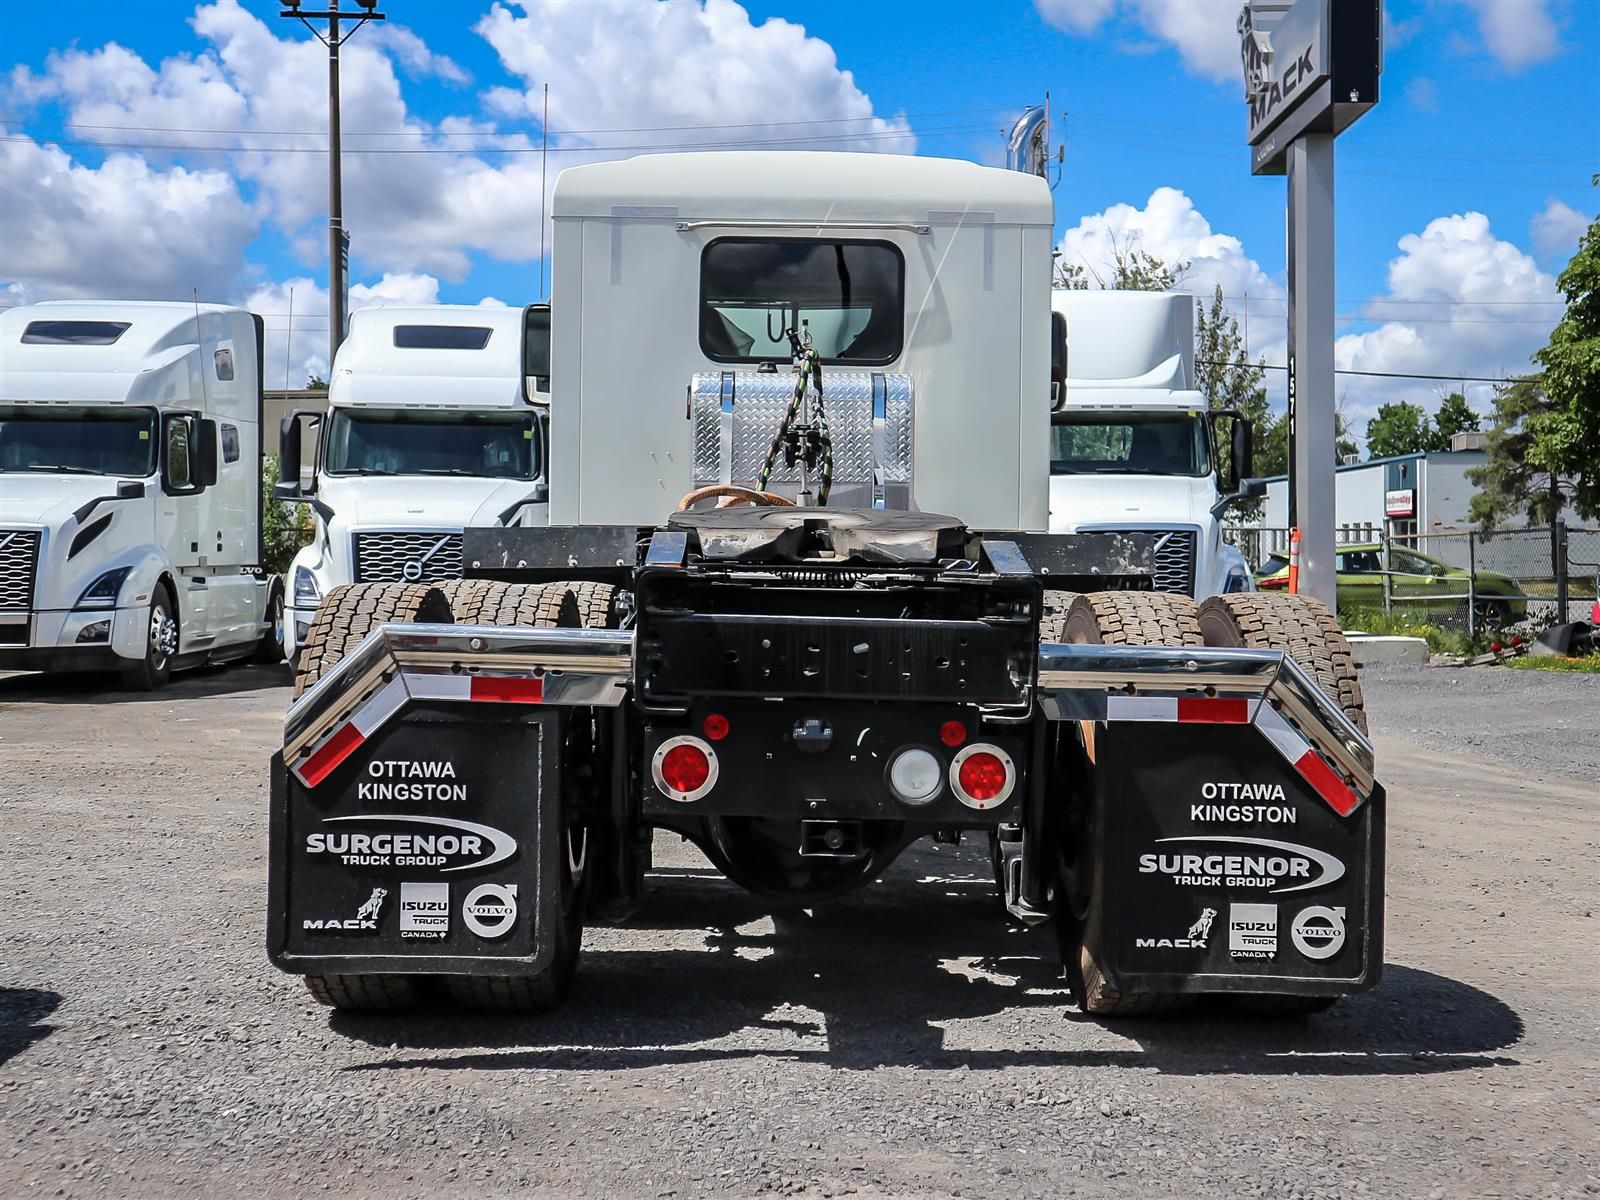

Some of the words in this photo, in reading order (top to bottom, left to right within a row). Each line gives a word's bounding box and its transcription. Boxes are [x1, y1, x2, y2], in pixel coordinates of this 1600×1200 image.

[1250, 44, 1314, 131] MACK
[369, 761, 455, 778] OTTAWA
[359, 783, 466, 800] KINGSTON
[1202, 783, 1285, 800] OTTAWA
[1191, 805, 1296, 823] KINGSTON
[307, 834, 482, 854] SURGENOR
[341, 856, 390, 865] TRUCK
[396, 856, 446, 865] GROUP
[1139, 853, 1310, 877] SURGENOR
[1173, 876, 1220, 886] TRUCK
[1226, 876, 1276, 887] GROUP
[402, 901, 447, 911] ISUZU
[467, 907, 513, 915] VOLVO
[303, 920, 376, 929] MACK
[1231, 922, 1276, 932] ISUZU
[1295, 928, 1341, 937] VOLVO
[1136, 938, 1207, 948] MACK
